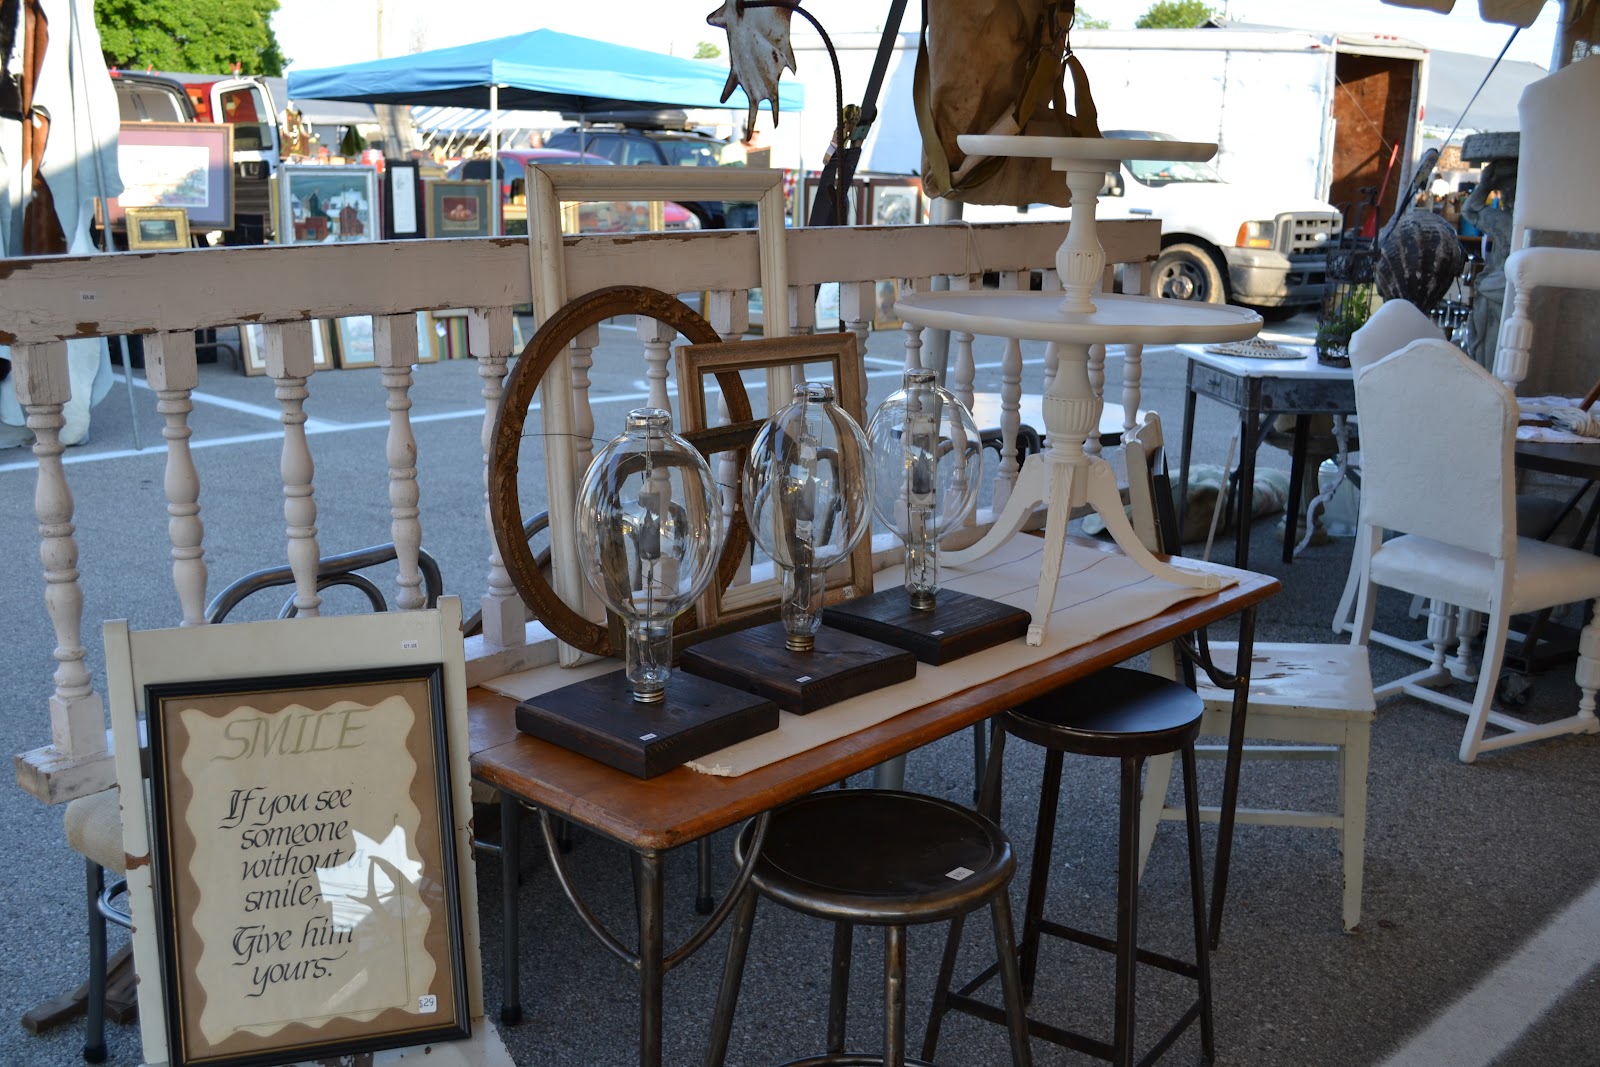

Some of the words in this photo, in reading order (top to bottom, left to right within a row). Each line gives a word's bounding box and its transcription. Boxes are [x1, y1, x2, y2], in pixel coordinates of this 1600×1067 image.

[210, 708, 373, 762] SMILE
[217, 786, 267, 829] If
[251, 792, 309, 826] you
[315, 788, 352, 811] see
[240, 820, 348, 850] someone
[242, 843, 345, 880] without
[232, 924, 293, 966] Give
[301, 915, 353, 948] him
[244, 950, 348, 998] yours.
[419, 996, 435, 1009] $29
